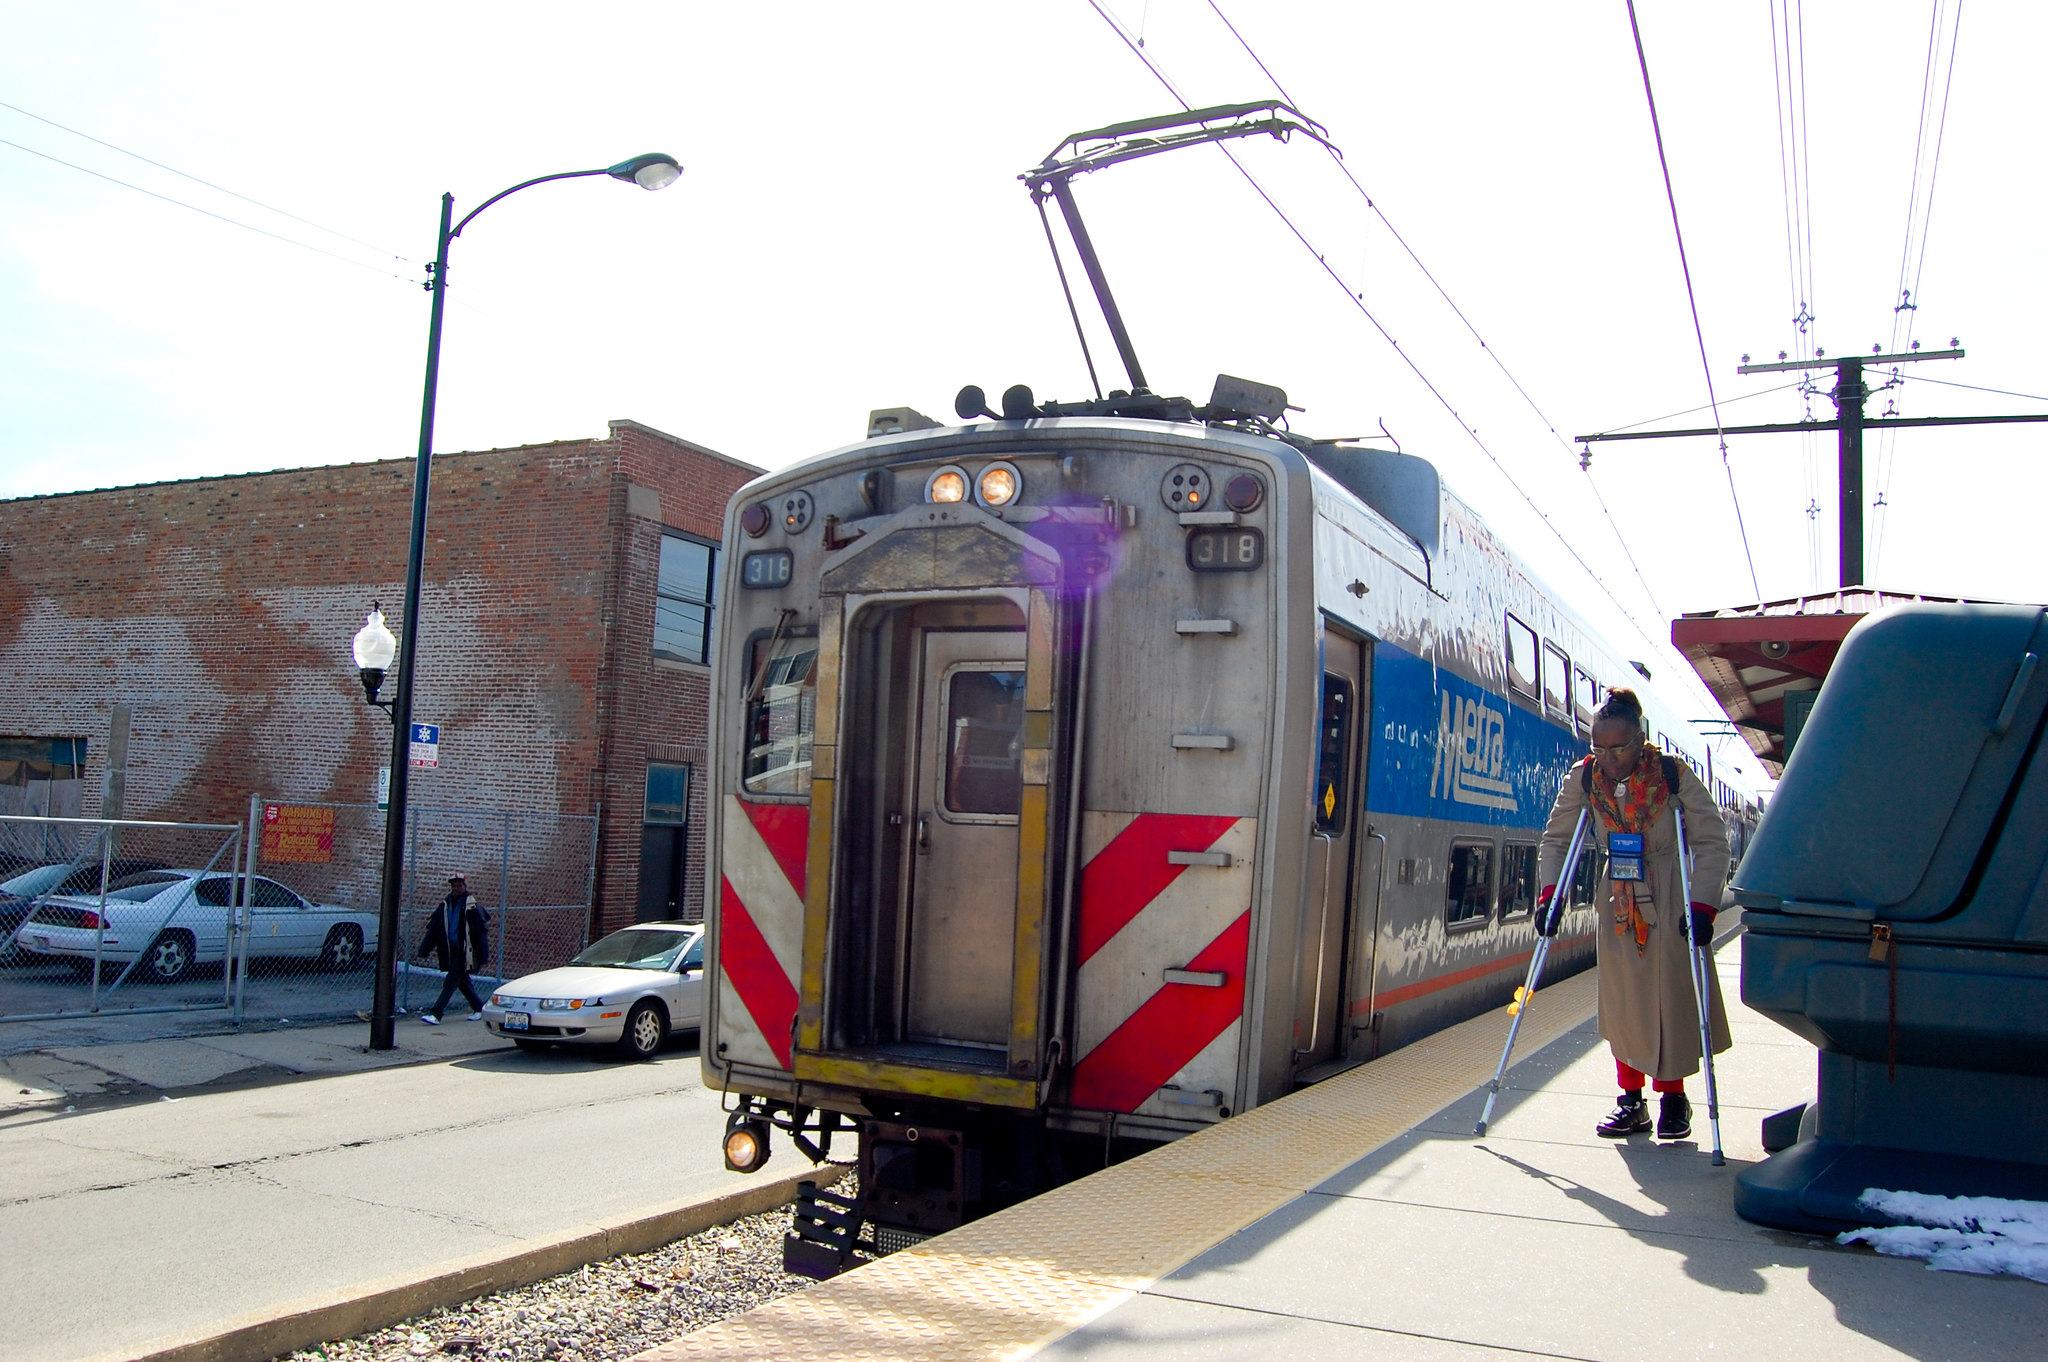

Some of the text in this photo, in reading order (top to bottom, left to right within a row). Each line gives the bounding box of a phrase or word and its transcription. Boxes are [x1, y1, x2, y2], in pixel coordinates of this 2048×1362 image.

[1198, 535, 1255, 563] 318
[751, 557, 790, 582] 318
[1430, 688, 1512, 806] Metra
[280, 806, 322, 818] WARNING
